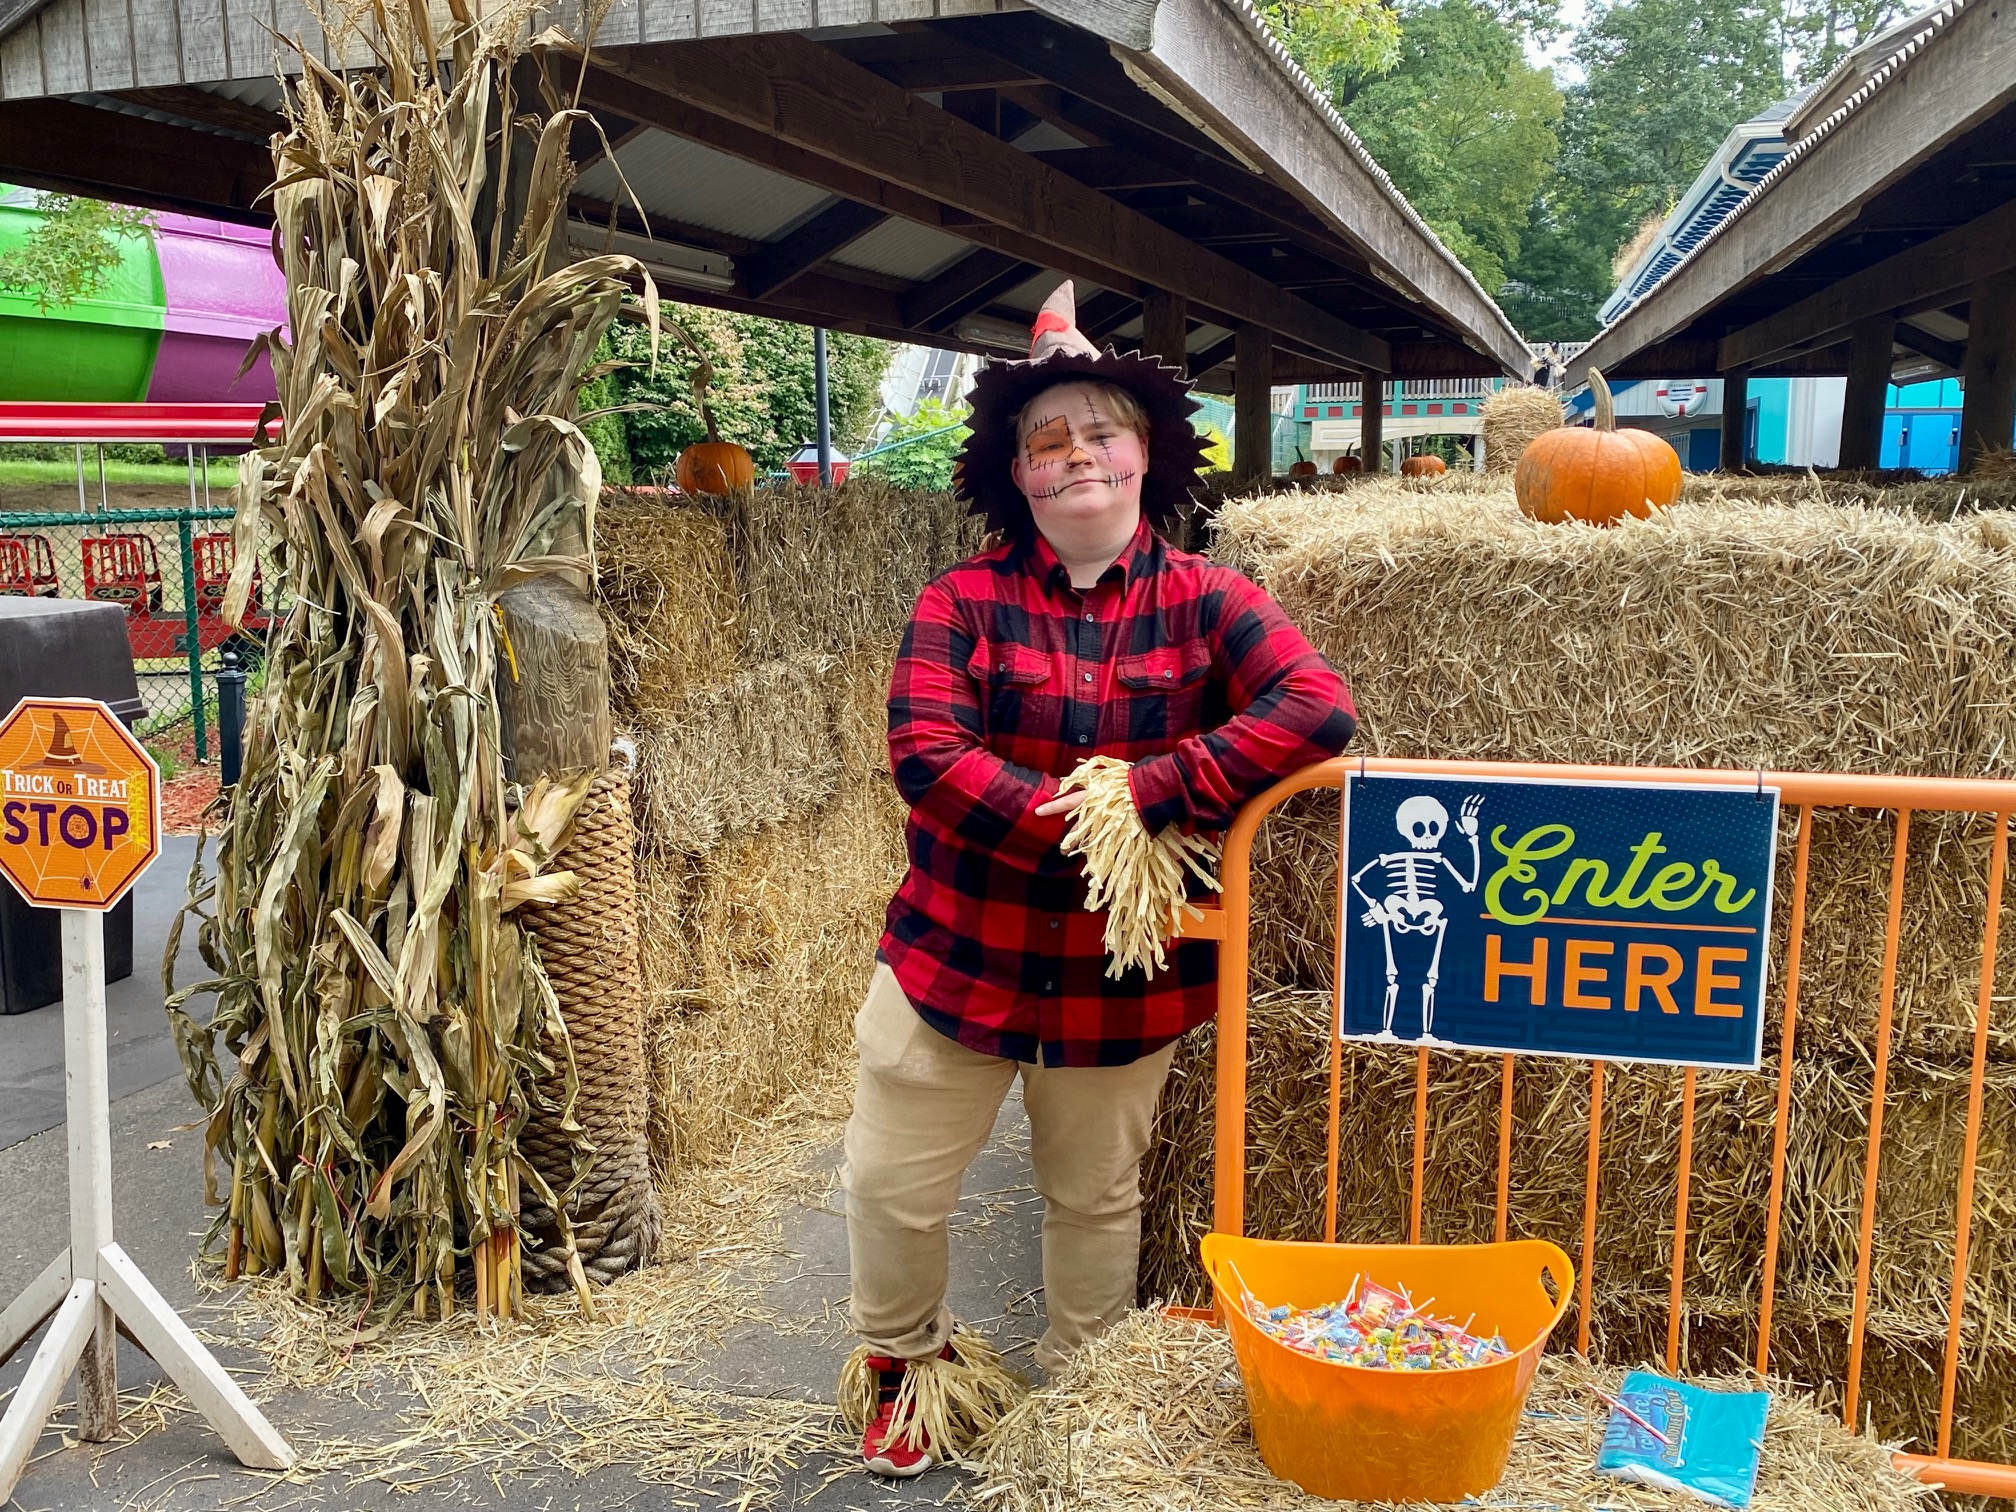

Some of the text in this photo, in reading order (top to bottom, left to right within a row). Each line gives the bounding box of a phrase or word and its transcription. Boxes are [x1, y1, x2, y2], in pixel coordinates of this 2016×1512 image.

[1, 769, 128, 799] TRICK OR TREAT
[2, 801, 129, 851] STOP
[1484, 823, 1757, 926] Enter
[1483, 934, 1748, 1018] HERE
[1664, 1388, 1686, 1416] COVE
